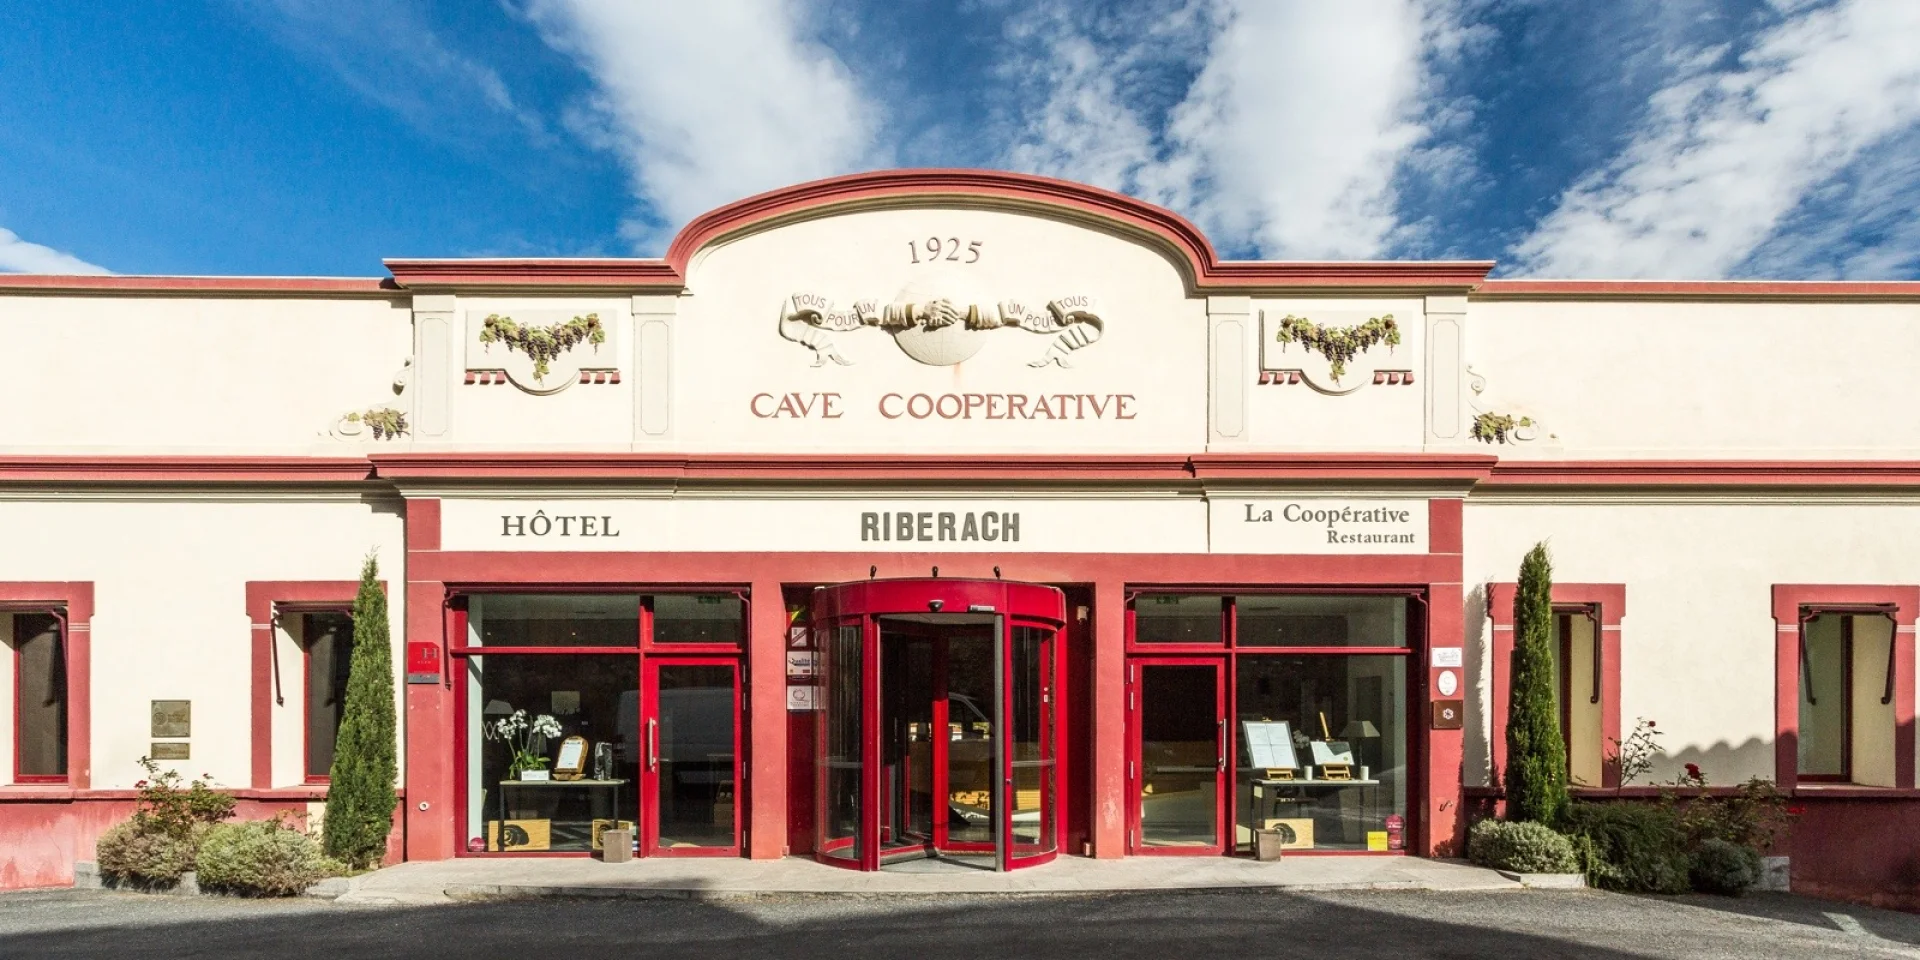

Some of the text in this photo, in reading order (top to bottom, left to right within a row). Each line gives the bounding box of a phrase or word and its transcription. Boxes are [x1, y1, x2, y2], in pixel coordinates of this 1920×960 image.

[908, 236, 983, 264] 1925
[796, 294, 876, 327] TOUS POUR UN
[1008, 303, 1025, 315] UN
[1057, 296, 1088, 309] TOUS
[750, 392, 1138, 420] CAVE COOPERATIVE
[501, 509, 620, 537] HÔTEL
[861, 511, 1020, 542] RIBERACH
[1244, 503, 1410, 528] La Coopérative
[1327, 530, 1415, 544] Restaurant
